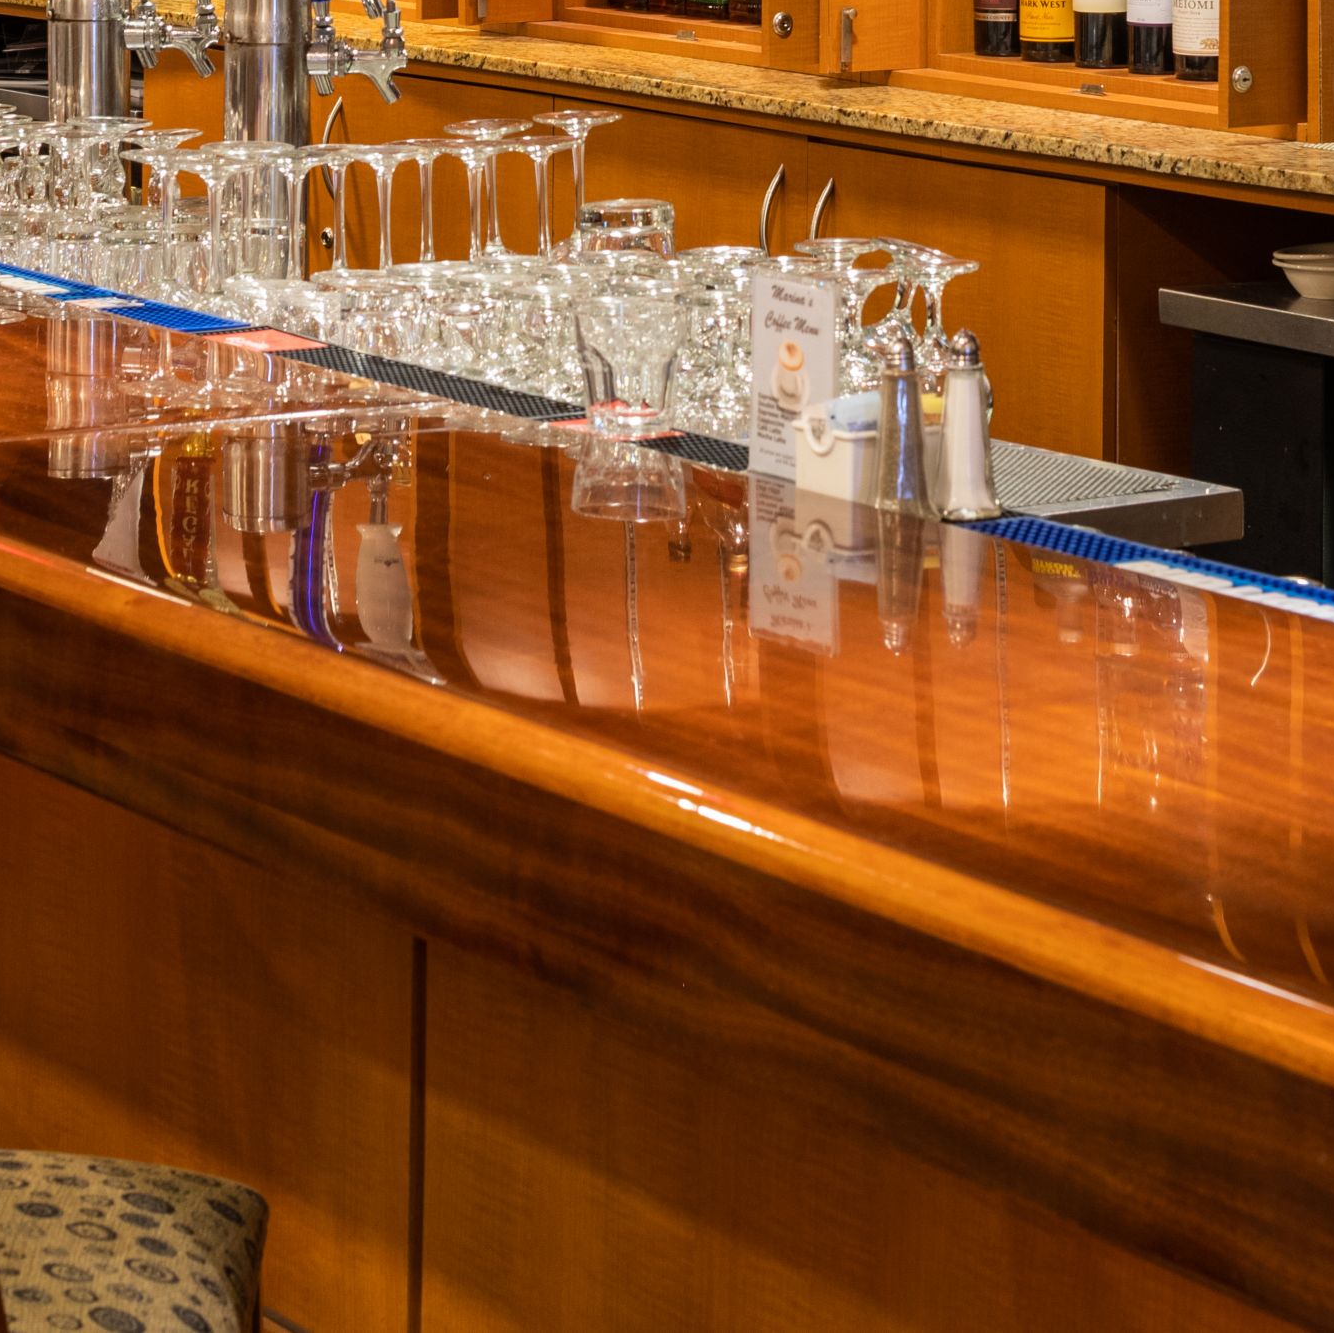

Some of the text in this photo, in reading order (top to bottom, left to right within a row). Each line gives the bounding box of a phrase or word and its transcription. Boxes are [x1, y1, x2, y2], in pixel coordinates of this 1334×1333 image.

[1040, 0, 1067, 9] WEST
[771, 284, 814, 308] Marina's
[764, 310, 820, 336] Coffee Menu
